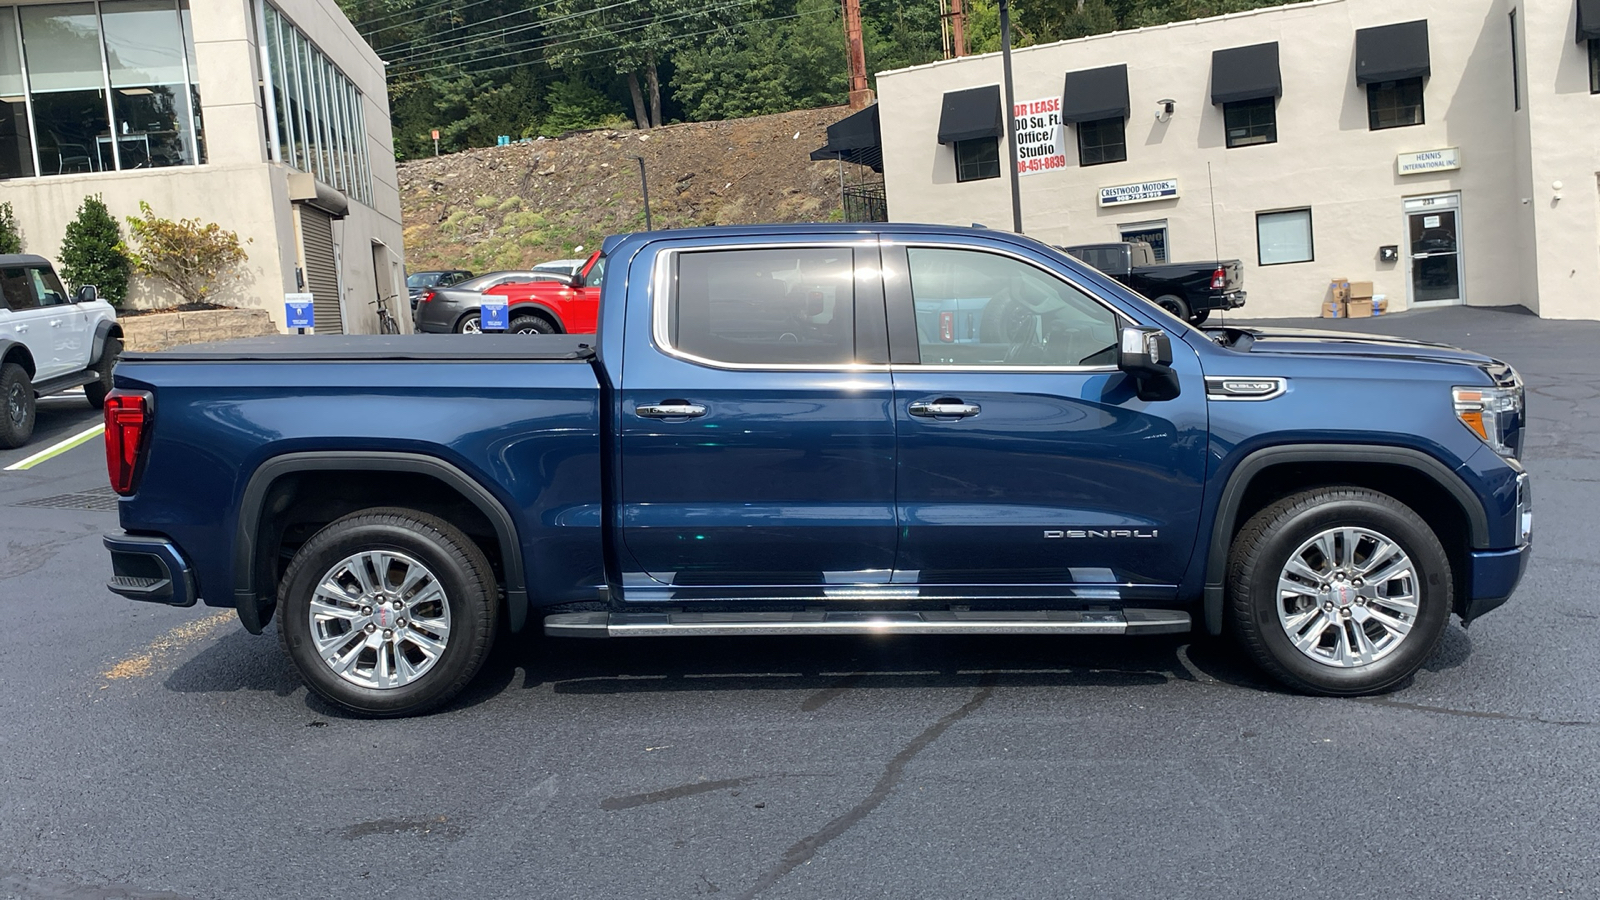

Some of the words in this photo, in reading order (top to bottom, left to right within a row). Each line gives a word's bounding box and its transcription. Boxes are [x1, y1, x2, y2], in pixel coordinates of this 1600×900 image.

[1014, 104, 1027, 117] OR
[1030, 98, 1060, 115] LEASE
[1015, 118, 1028, 131] 00
[1030, 116, 1047, 128] Sq.
[1049, 114, 1062, 126] Ft.
[1018, 128, 1054, 145] Office/
[1019, 143, 1055, 159] Studio
[1416, 152, 1442, 161] HENNIS
[1017, 155, 1066, 173] 08-451-8839
[1403, 160, 1446, 170] INTERNATIONAL
[1101, 185, 1140, 197] CRESTWOOD
[1142, 182, 1169, 192] MOTORS
[1043, 529, 1158, 539] DENALI
